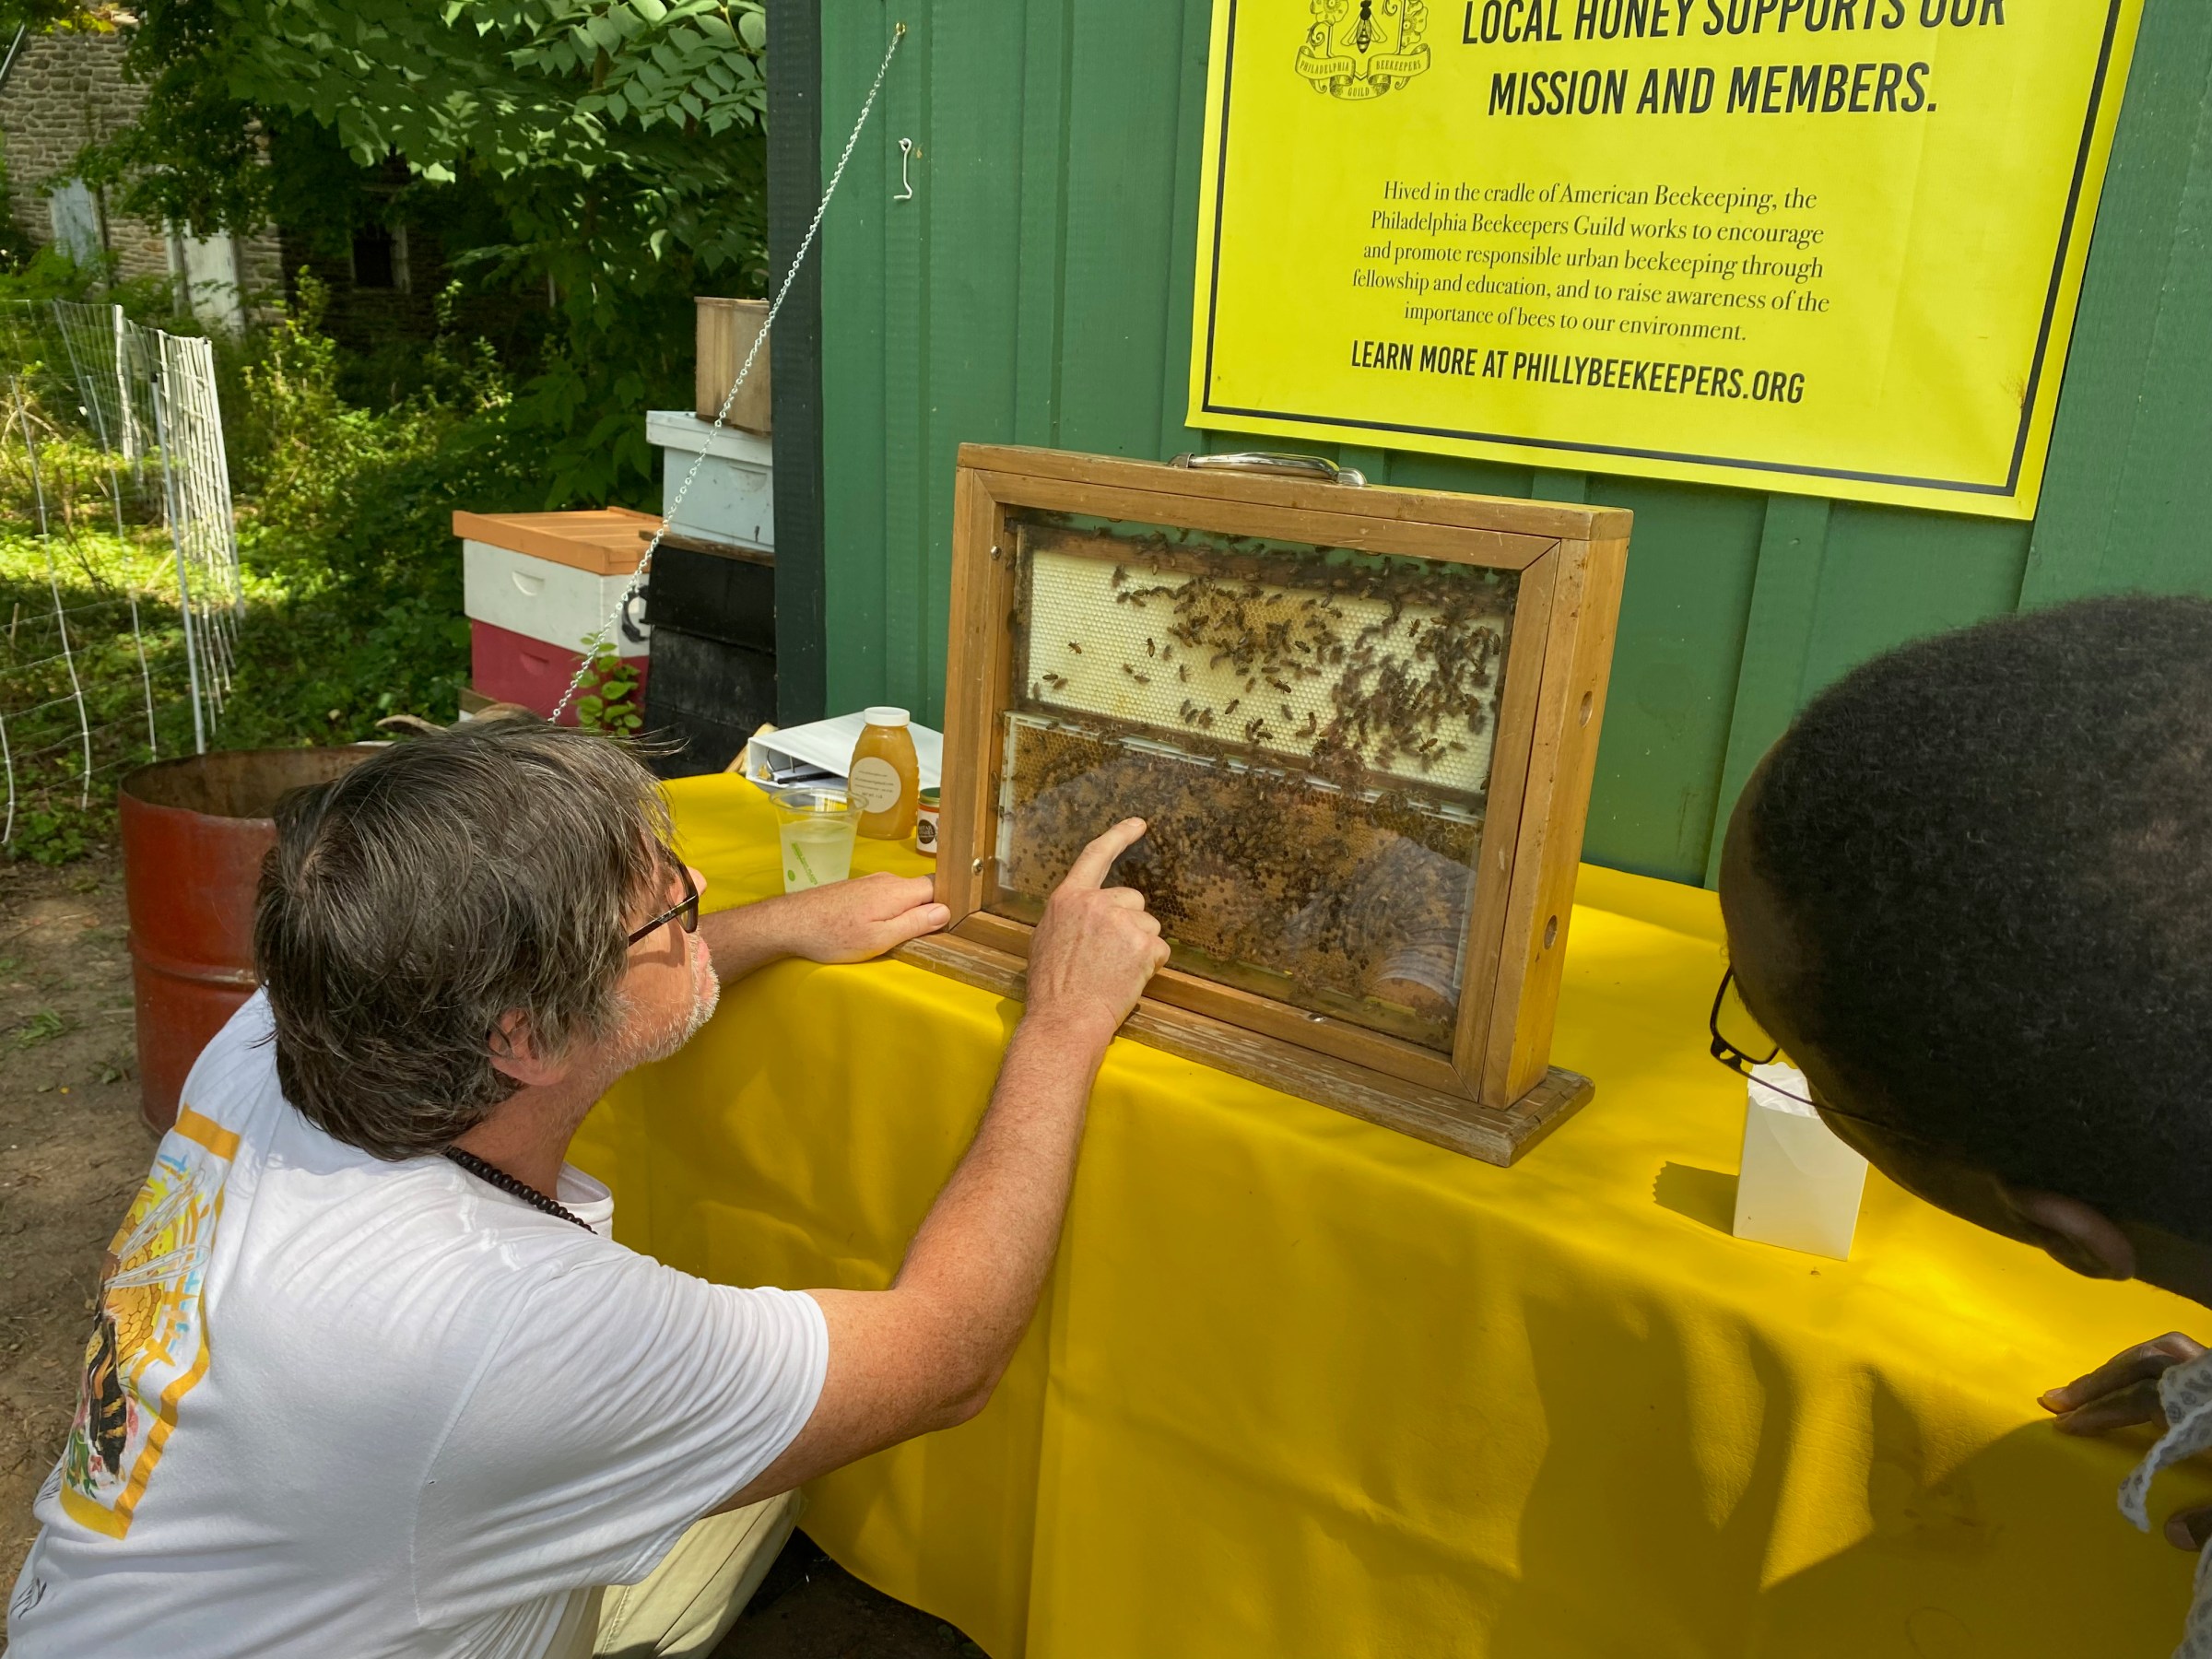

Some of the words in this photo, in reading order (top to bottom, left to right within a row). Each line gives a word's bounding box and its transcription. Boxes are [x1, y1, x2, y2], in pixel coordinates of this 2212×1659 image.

[1462, 0, 1562, 45] LOCAL
[1573, 0, 1695, 41] HONEY
[1702, 0, 1905, 36] SUPPORTS
[1300, 59, 1349, 74] PHILADELPHIA
[1376, 59, 1421, 72] BEEKEEPERS
[1347, 86, 1371, 98] GUILD
[1488, 70, 1629, 116] MISSION
[1635, 67, 1715, 114] AND
[1725, 61, 1937, 114] MEMBERS.
[1384, 181, 1431, 200] Hived
[1434, 182, 1450, 200] in
[1454, 182, 1480, 201] the
[1484, 182, 1535, 202] cradle
[1538, 182, 1560, 203] of
[1560, 182, 1649, 205] American
[1654, 184, 1777, 215] Beekeeping,
[1784, 187, 1818, 209] the
[1371, 210, 1466, 237] Philadelphia
[1472, 213, 1569, 241] Beekeepers
[1573, 215, 1626, 237] Guild
[1630, 218, 1687, 239] works
[1692, 224, 1712, 240] to
[1716, 227, 1824, 251] encourage
[1363, 241, 1392, 259] and
[1394, 247, 1462, 265] promote
[1466, 245, 1561, 269] responsible
[1566, 247, 1618, 268] urban
[1624, 249, 1738, 281] beekeeping
[1742, 254, 1823, 285] through
[1353, 268, 1430, 296] fellowship
[1433, 273, 1463, 292] and
[1465, 274, 1551, 298] education,
[1556, 278, 1590, 299] and
[1594, 285, 1613, 300] to
[1618, 282, 1662, 303] raise
[1666, 290, 1766, 309] awareness
[1771, 289, 1796, 311] of
[1797, 290, 1830, 312] the
[1405, 300, 1494, 326] importance
[1497, 306, 1518, 325] of
[1517, 306, 1556, 327] bees
[1560, 314, 1578, 329] to
[1583, 317, 1616, 332] our
[1618, 315, 1746, 341] environment.
[1351, 339, 1414, 371] LEARN
[1418, 345, 1478, 377] MORE
[1481, 349, 1510, 379] AT
[1512, 351, 1806, 404] PHILLYBEEKEEPERS.ORG
